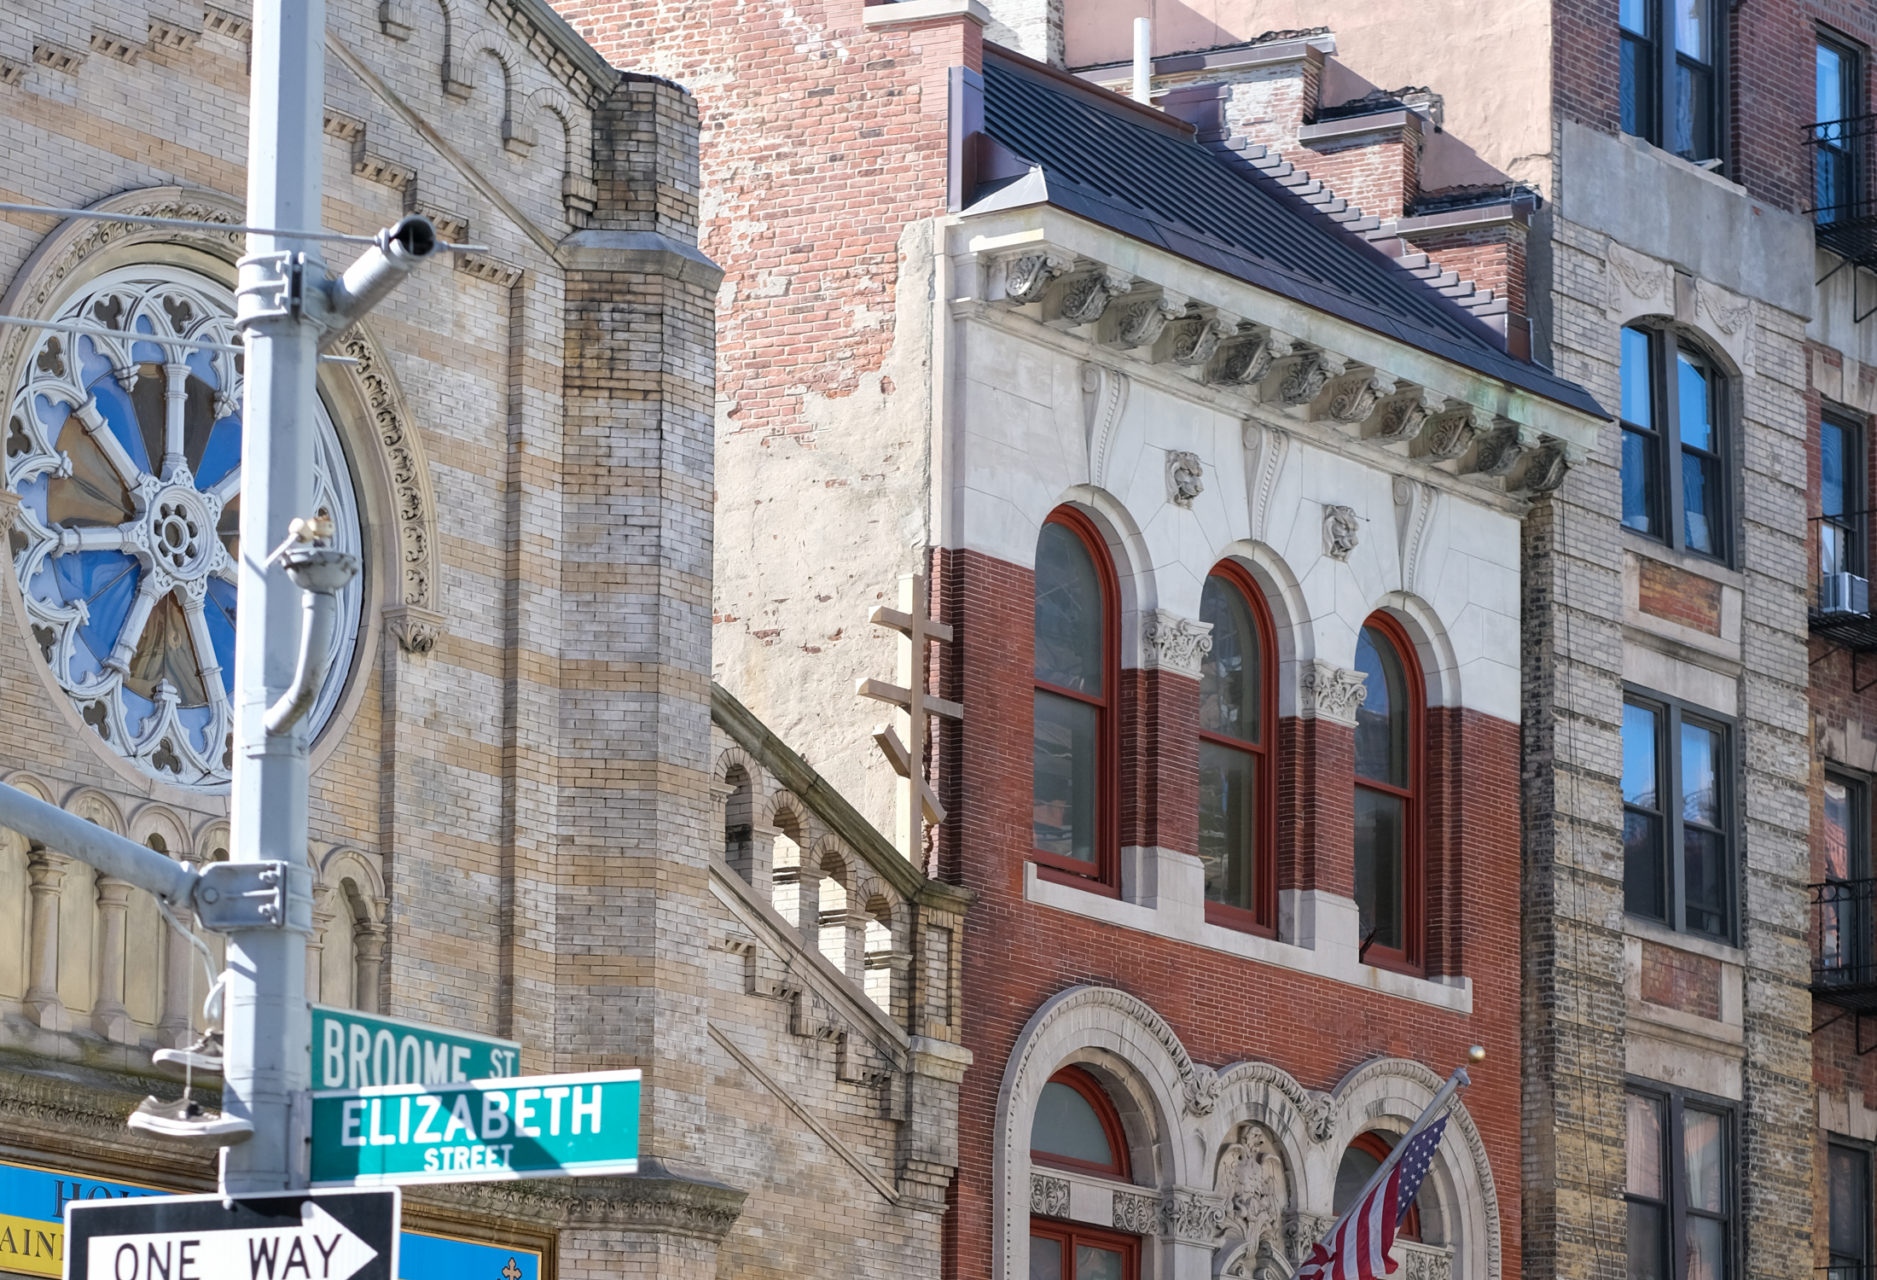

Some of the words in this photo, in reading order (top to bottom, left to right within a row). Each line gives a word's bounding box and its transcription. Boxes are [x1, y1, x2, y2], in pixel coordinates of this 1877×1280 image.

[323, 1018, 471, 1088] BROOME
[489, 1048, 516, 1079] ST
[341, 1085, 603, 1147] ELIZABETH
[423, 1145, 514, 1172] STREET
